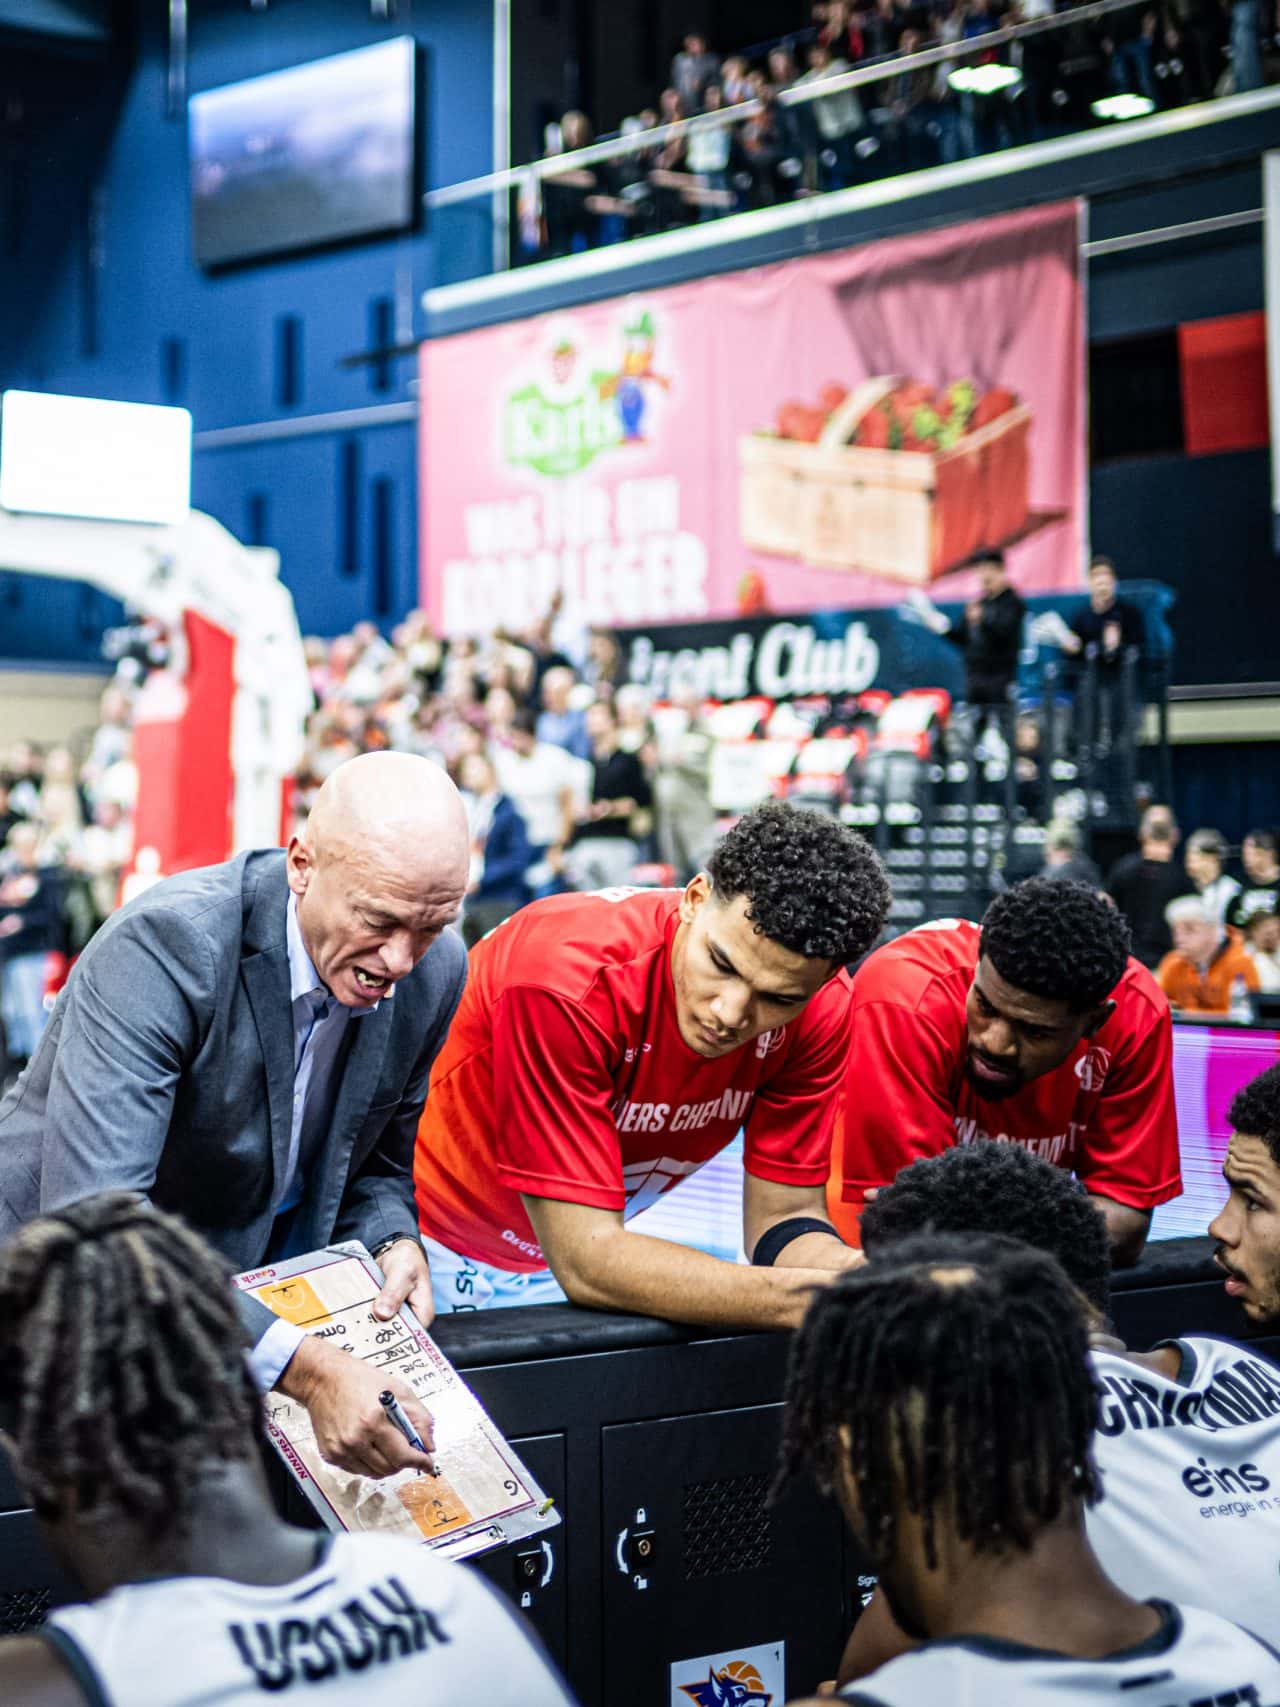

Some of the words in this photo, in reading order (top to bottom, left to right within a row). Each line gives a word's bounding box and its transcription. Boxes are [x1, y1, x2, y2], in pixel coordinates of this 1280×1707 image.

[756, 622, 880, 698] Club
[277, 1438, 308, 1480] NINERS
[1181, 1456, 1271, 1498] eins
